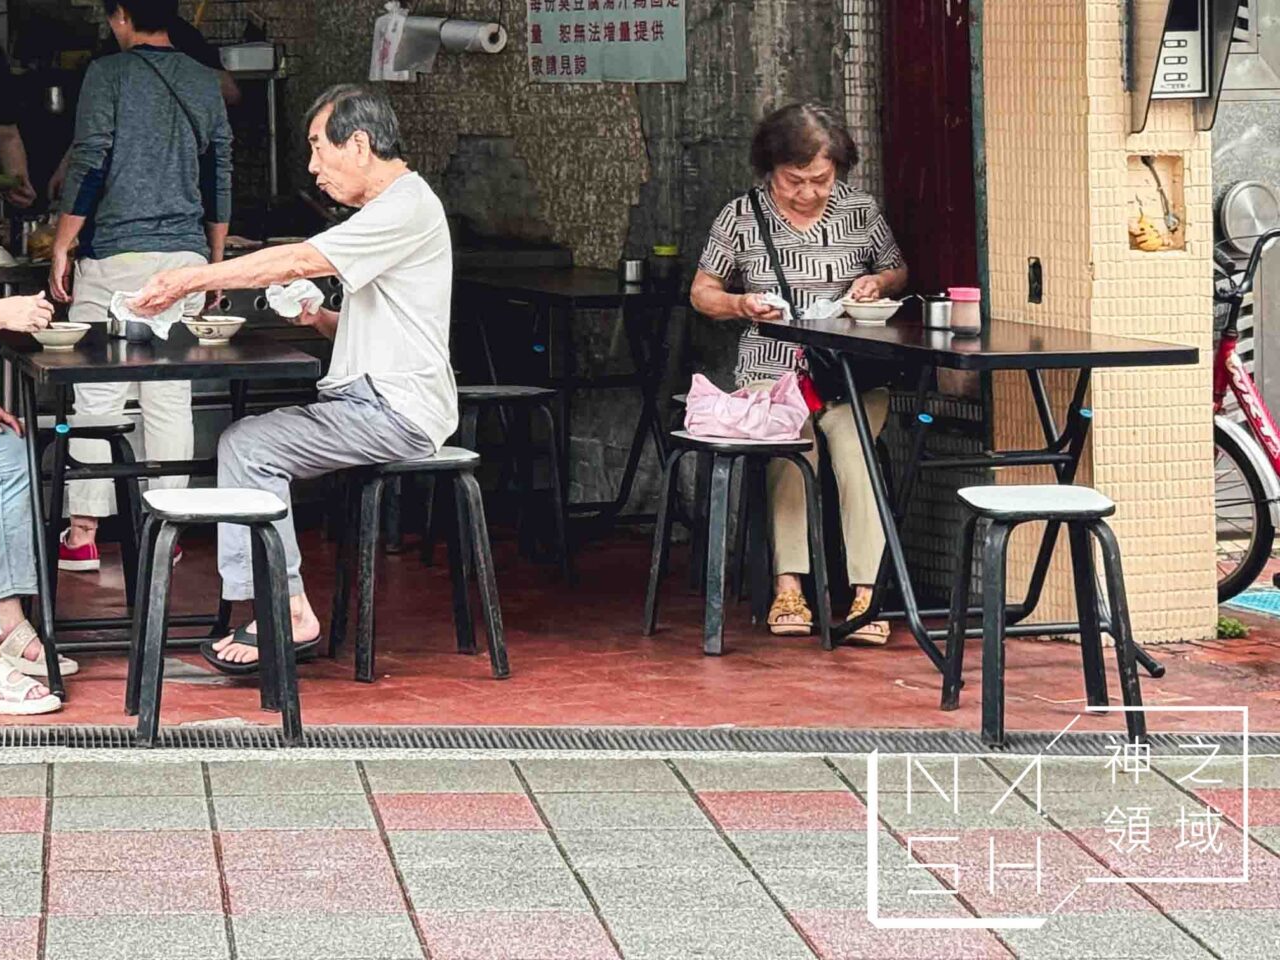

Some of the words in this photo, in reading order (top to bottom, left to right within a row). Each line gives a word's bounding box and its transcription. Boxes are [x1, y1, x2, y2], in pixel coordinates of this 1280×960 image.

[558, 19, 664, 44] 恕無法增量提供
[530, 54, 587, 76] 敬請見諒
